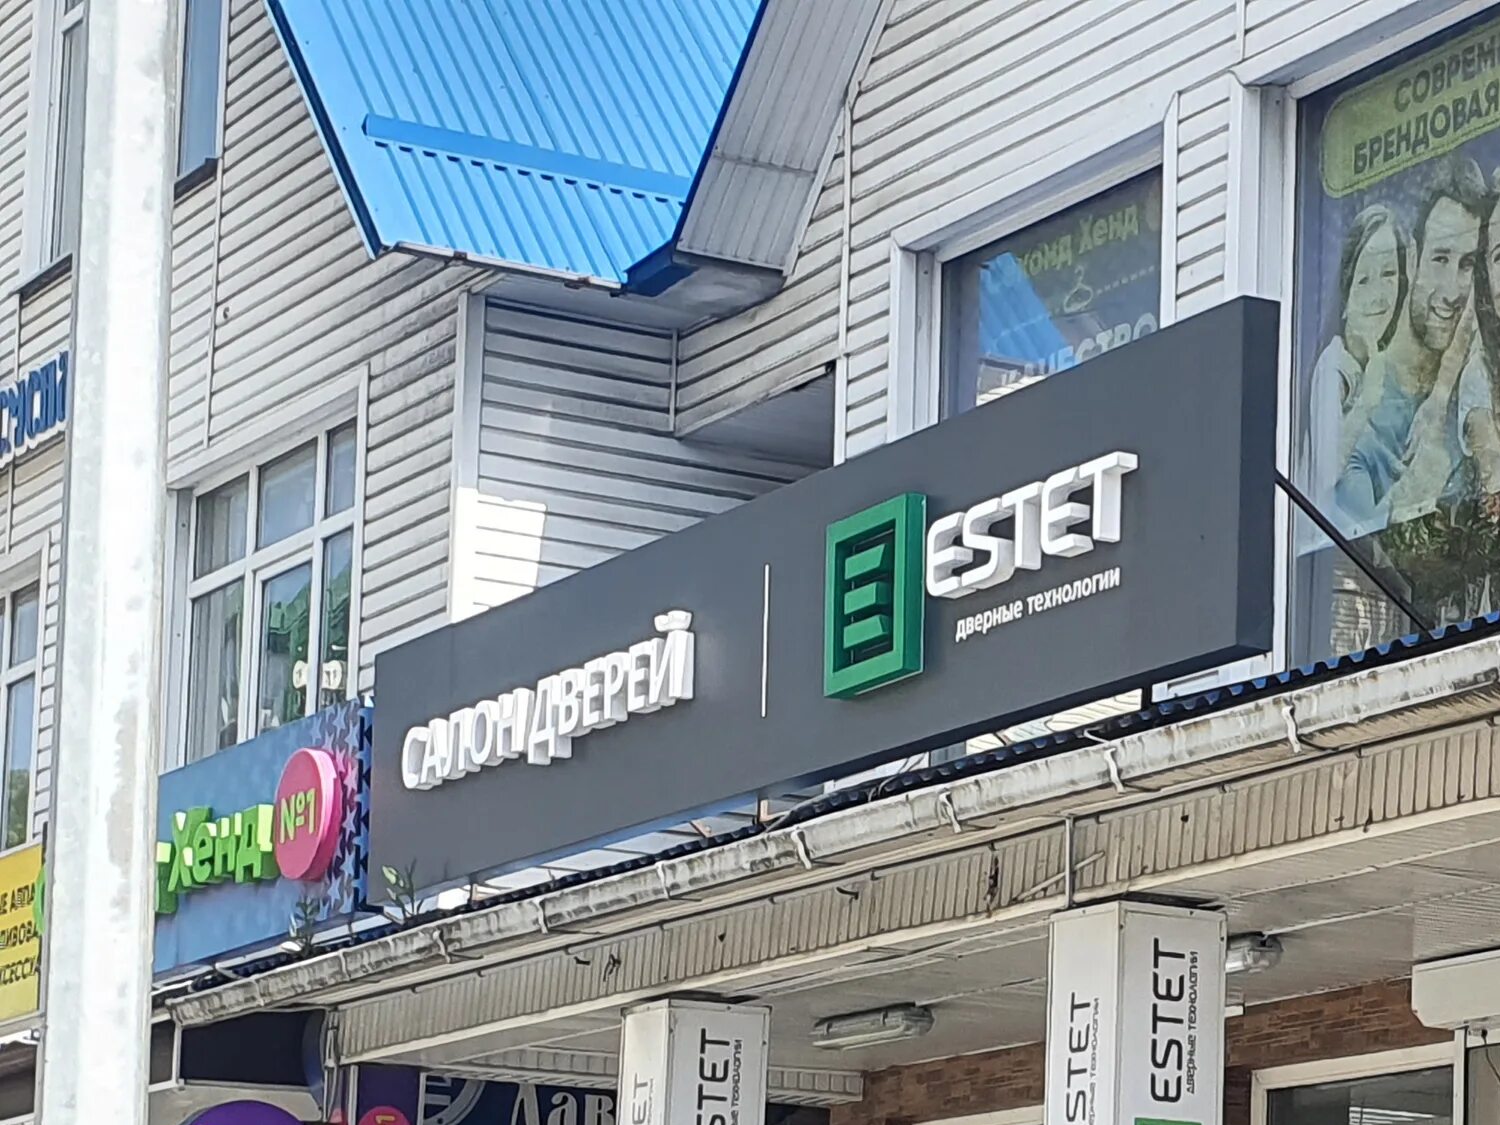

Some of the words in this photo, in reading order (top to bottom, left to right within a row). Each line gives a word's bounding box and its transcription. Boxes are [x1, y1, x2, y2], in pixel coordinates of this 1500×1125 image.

[1353, 84, 1500, 175] БРЕНДОВАЯ
[1078, 204, 1138, 254] Хенд
[926, 451, 1138, 600] ESTET
[955, 599, 1022, 643] дверные
[1026, 566, 1121, 616] технологии
[401, 687, 535, 791] САЛОН
[528, 610, 695, 766] ДВЕРЕЙ
[279, 787, 317, 845] №1
[1150, 937, 1186, 1103] ESTET
